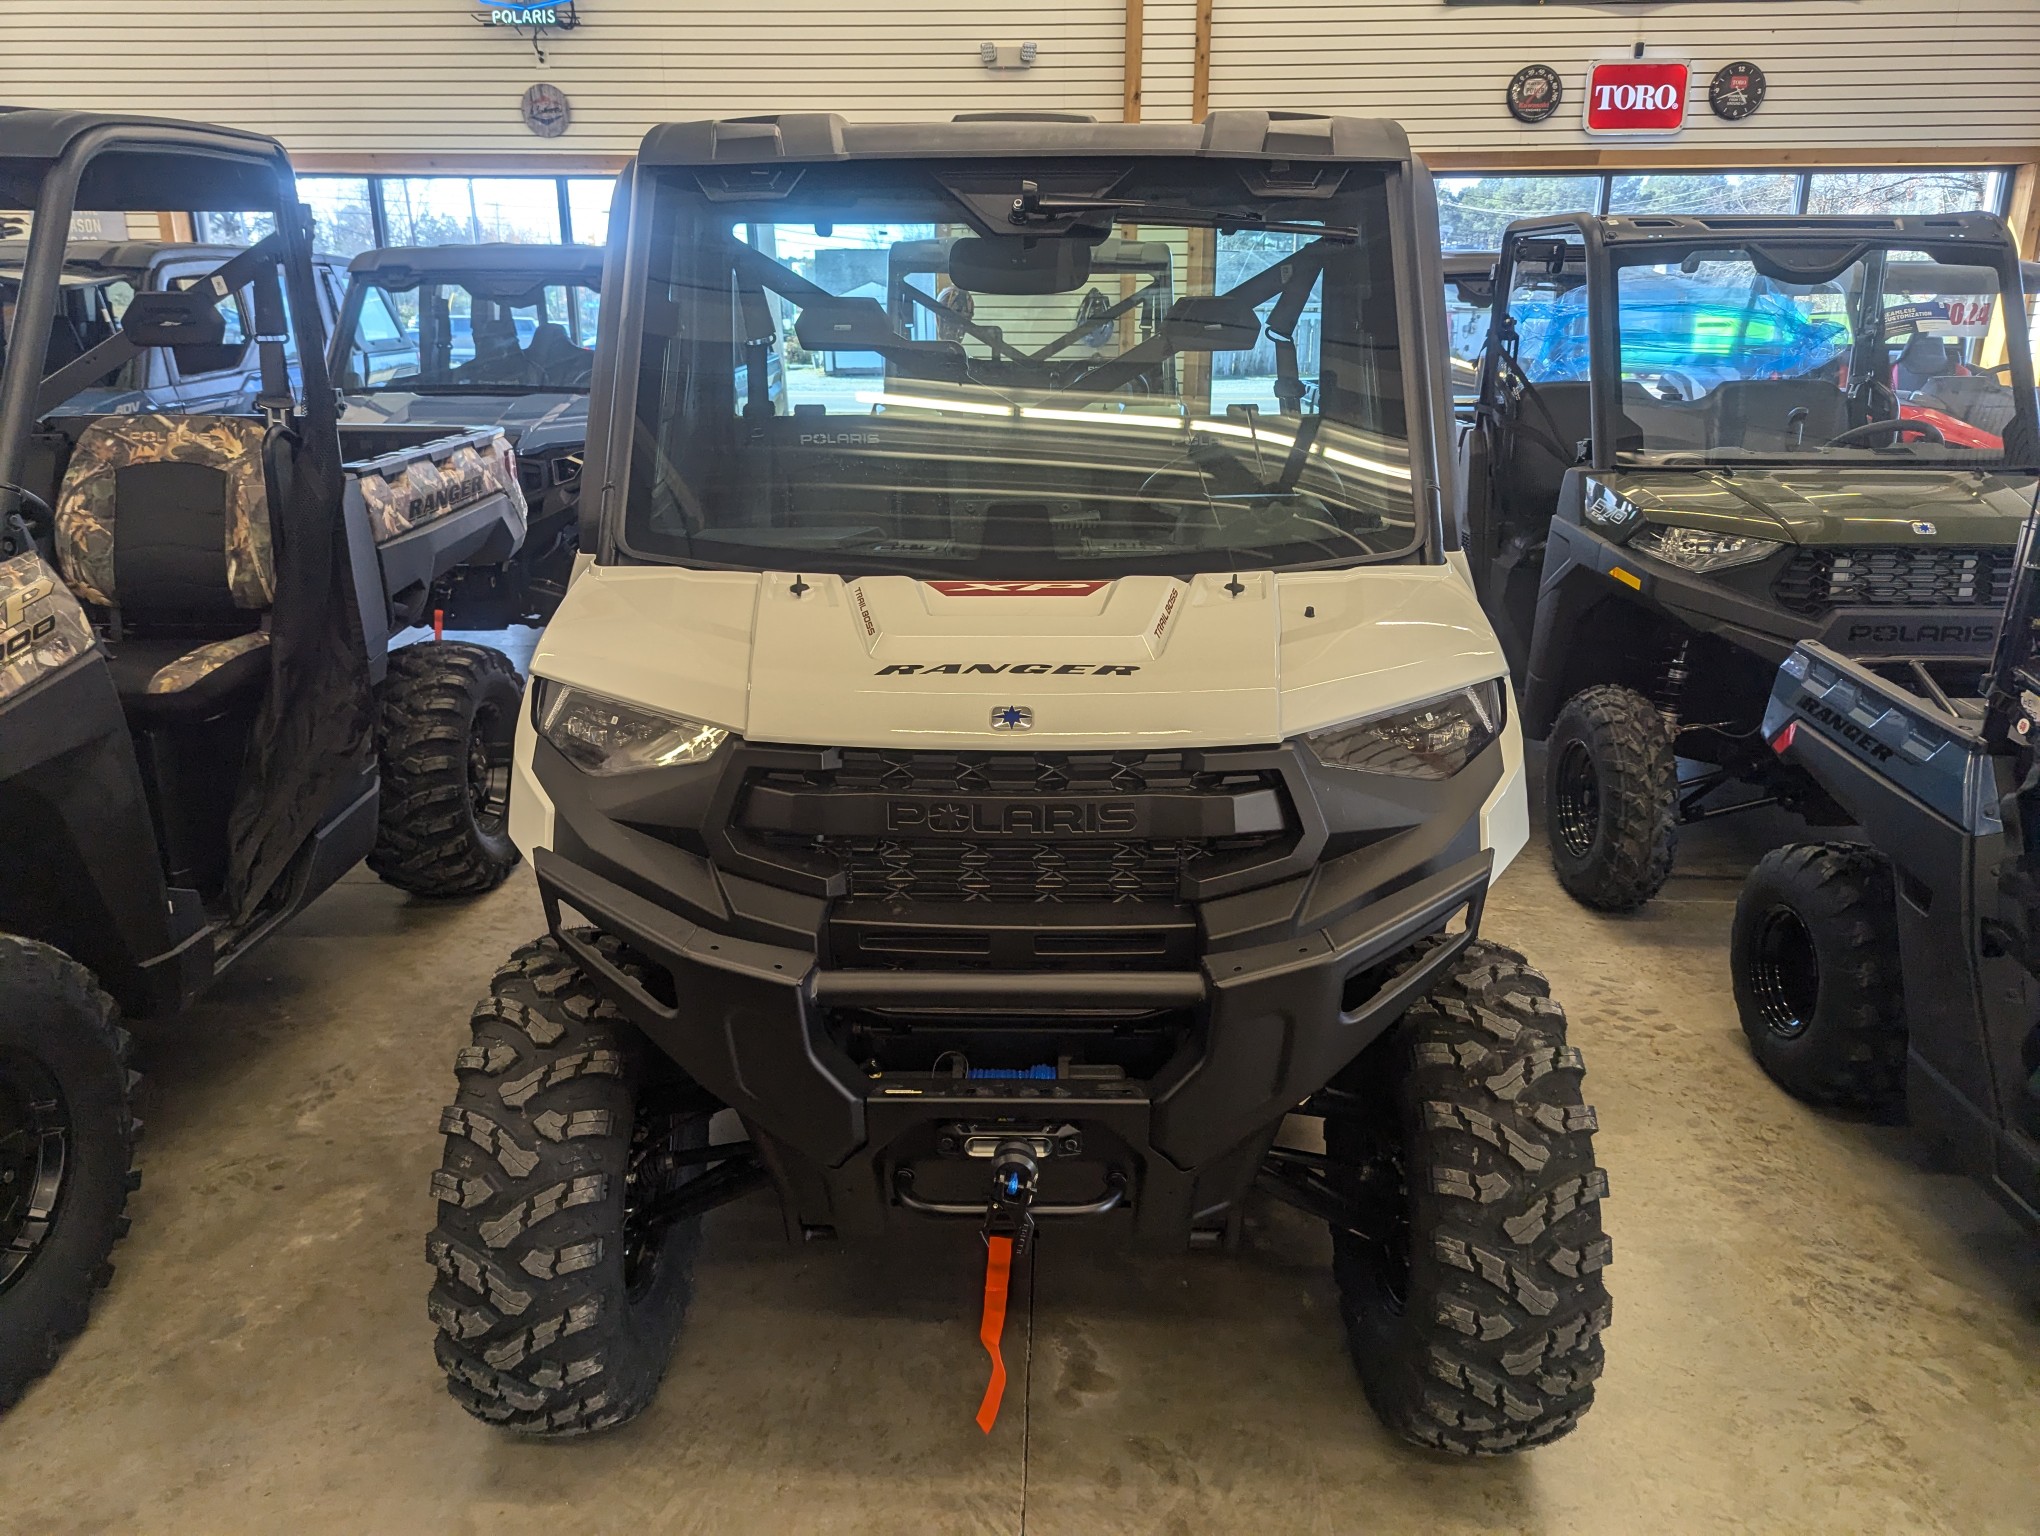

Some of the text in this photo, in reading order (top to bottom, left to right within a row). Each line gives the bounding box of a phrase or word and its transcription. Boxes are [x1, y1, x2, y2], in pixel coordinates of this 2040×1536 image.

[491, 9, 556, 24] POLARIS
[115, 401, 140, 415] ADV
[800, 433, 880, 445] POLARIS
[409, 475, 484, 520] RANGER
[1592, 498, 1628, 524] 570
[945, 583, 1091, 592] XP
[854, 586, 876, 636] TRAIL BOSS
[1154, 587, 1179, 639] TRAIL BOSS
[1848, 625, 1994, 643] POLARIS
[874, 663, 1142, 676] RANGER
[1795, 694, 1894, 763] RANGER
[886, 801, 1138, 834] POLARIS
